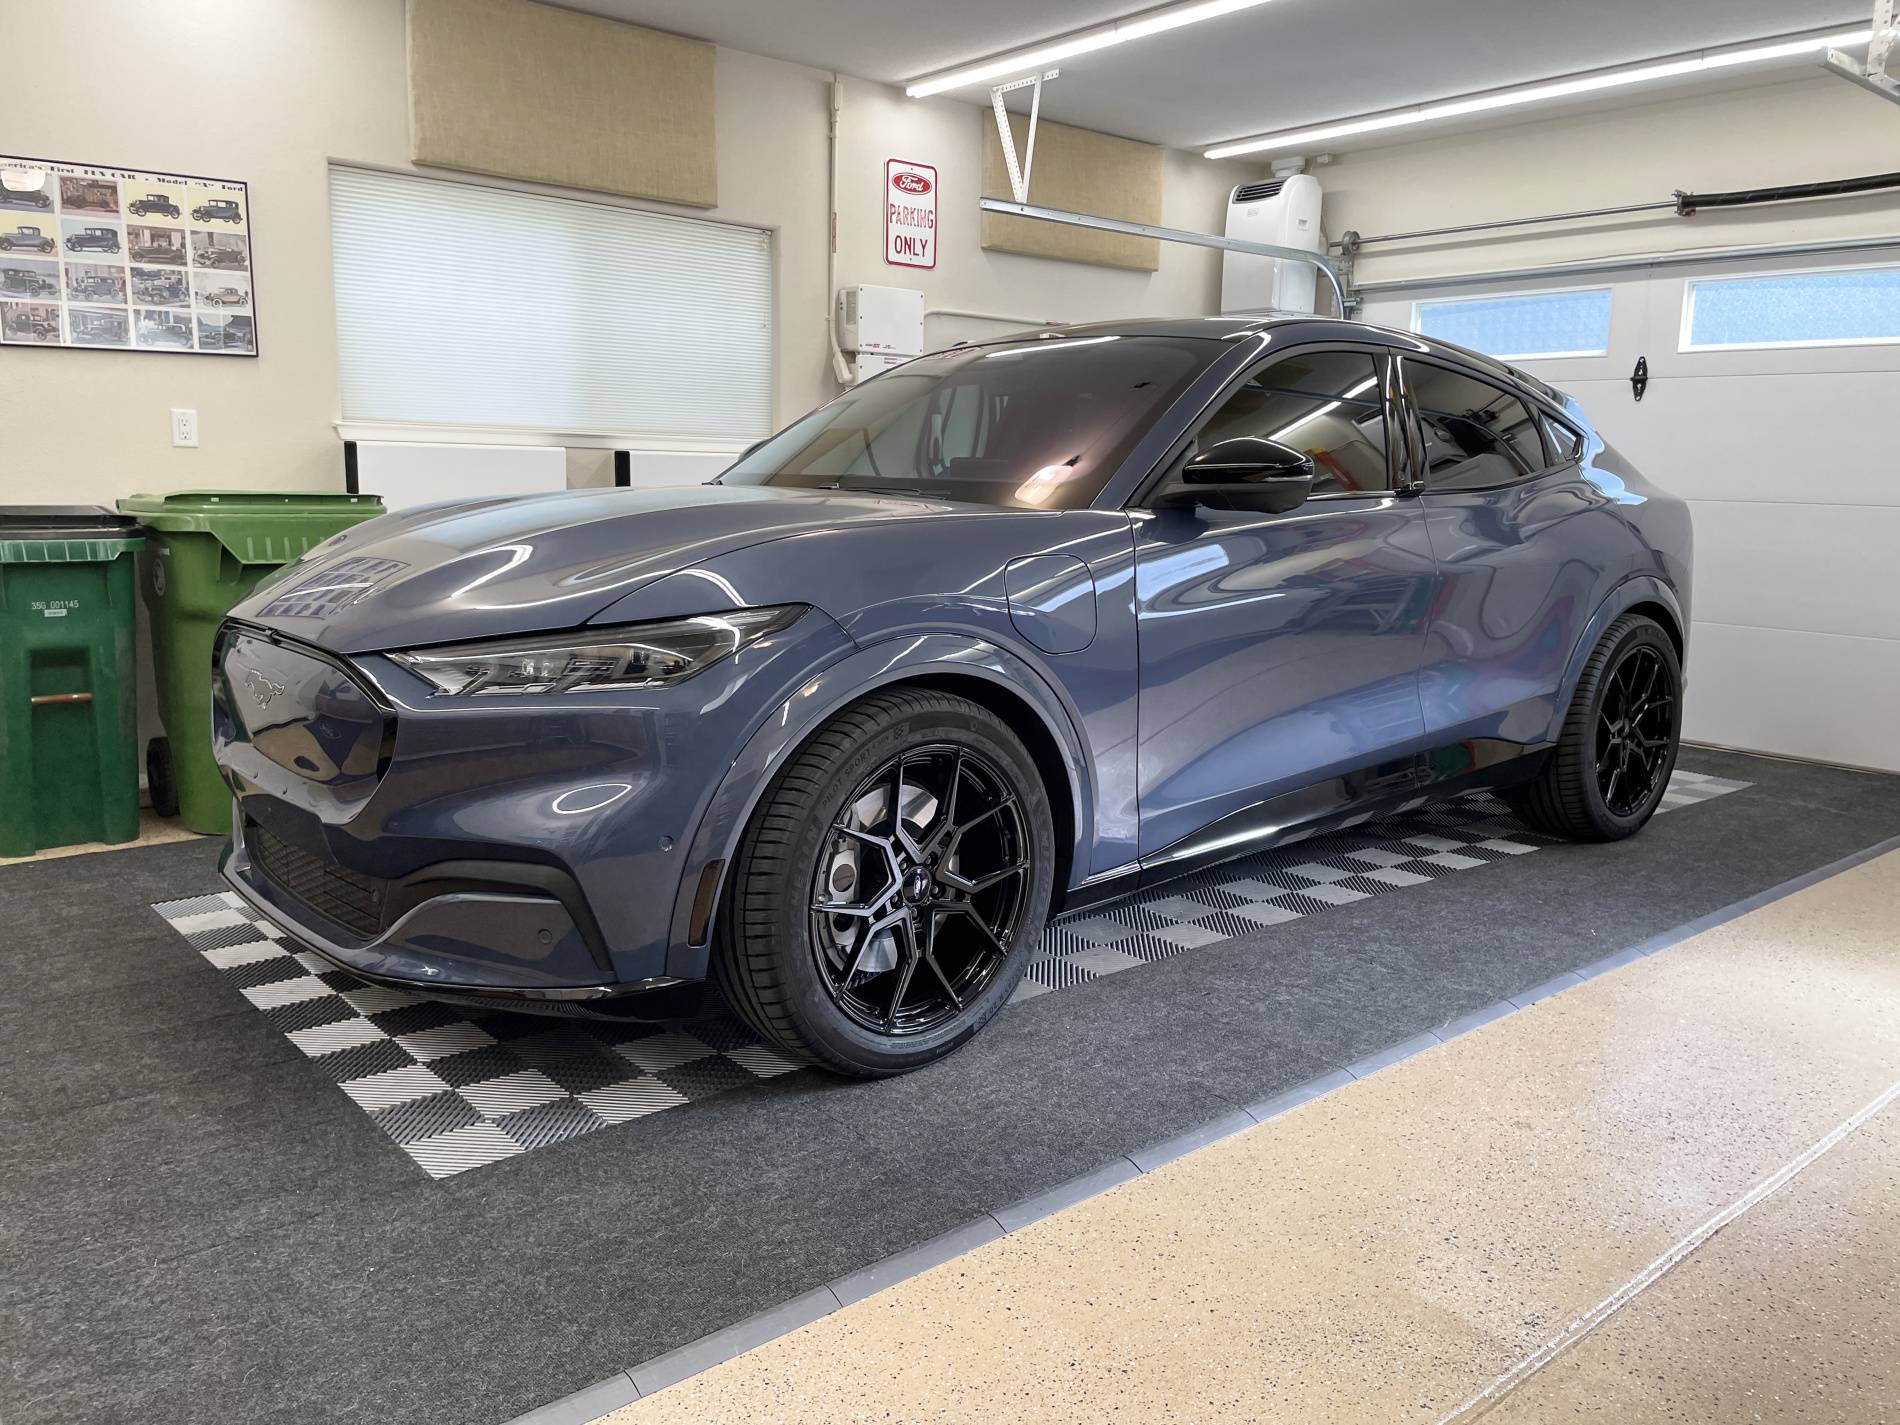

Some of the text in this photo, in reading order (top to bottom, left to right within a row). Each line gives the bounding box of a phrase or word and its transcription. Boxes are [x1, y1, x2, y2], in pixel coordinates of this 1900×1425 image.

[156, 176, 189, 186] Model
[221, 184, 244, 192] Ford
[899, 175, 924, 192] Ford
[889, 203, 934, 229] PARKING
[894, 235, 928, 258] ONLY
[821, 747, 871, 805] PILOT SPORT
